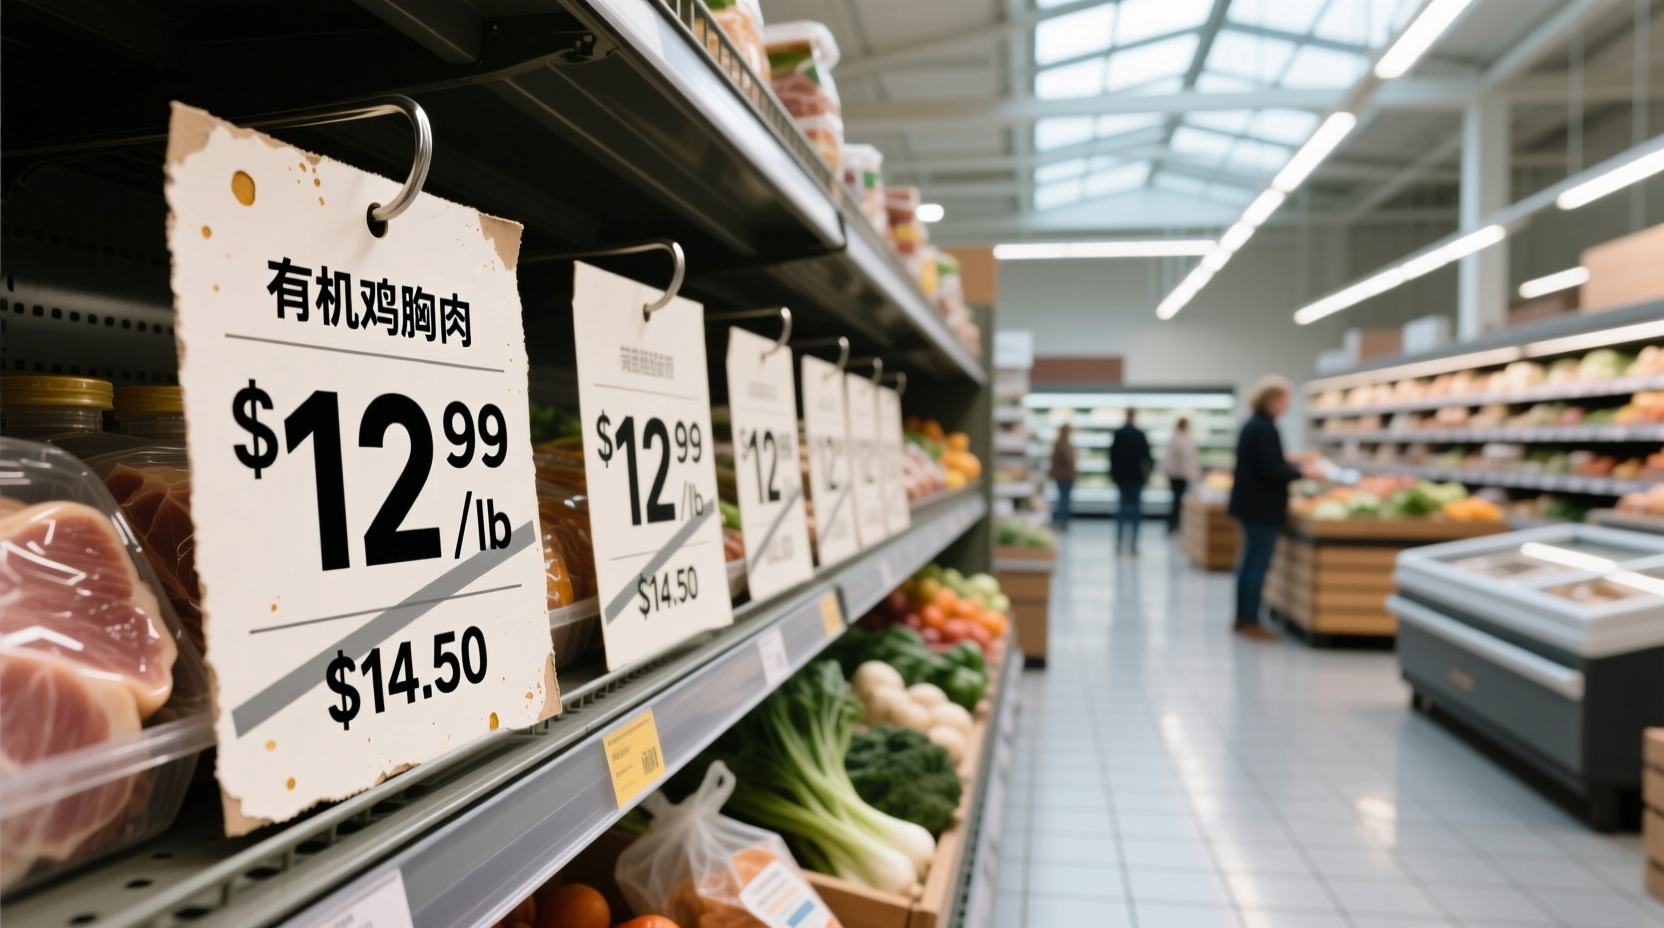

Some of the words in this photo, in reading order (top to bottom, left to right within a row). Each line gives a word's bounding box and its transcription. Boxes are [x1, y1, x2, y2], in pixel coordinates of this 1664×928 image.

[266, 256, 472, 348] 有机鸡胸肉
[454, 490, 512, 560] /lb
[680, 480, 704, 521] /lb
[637, 565, 699, 620] $14.50
[325, 625, 488, 731] $14.50
